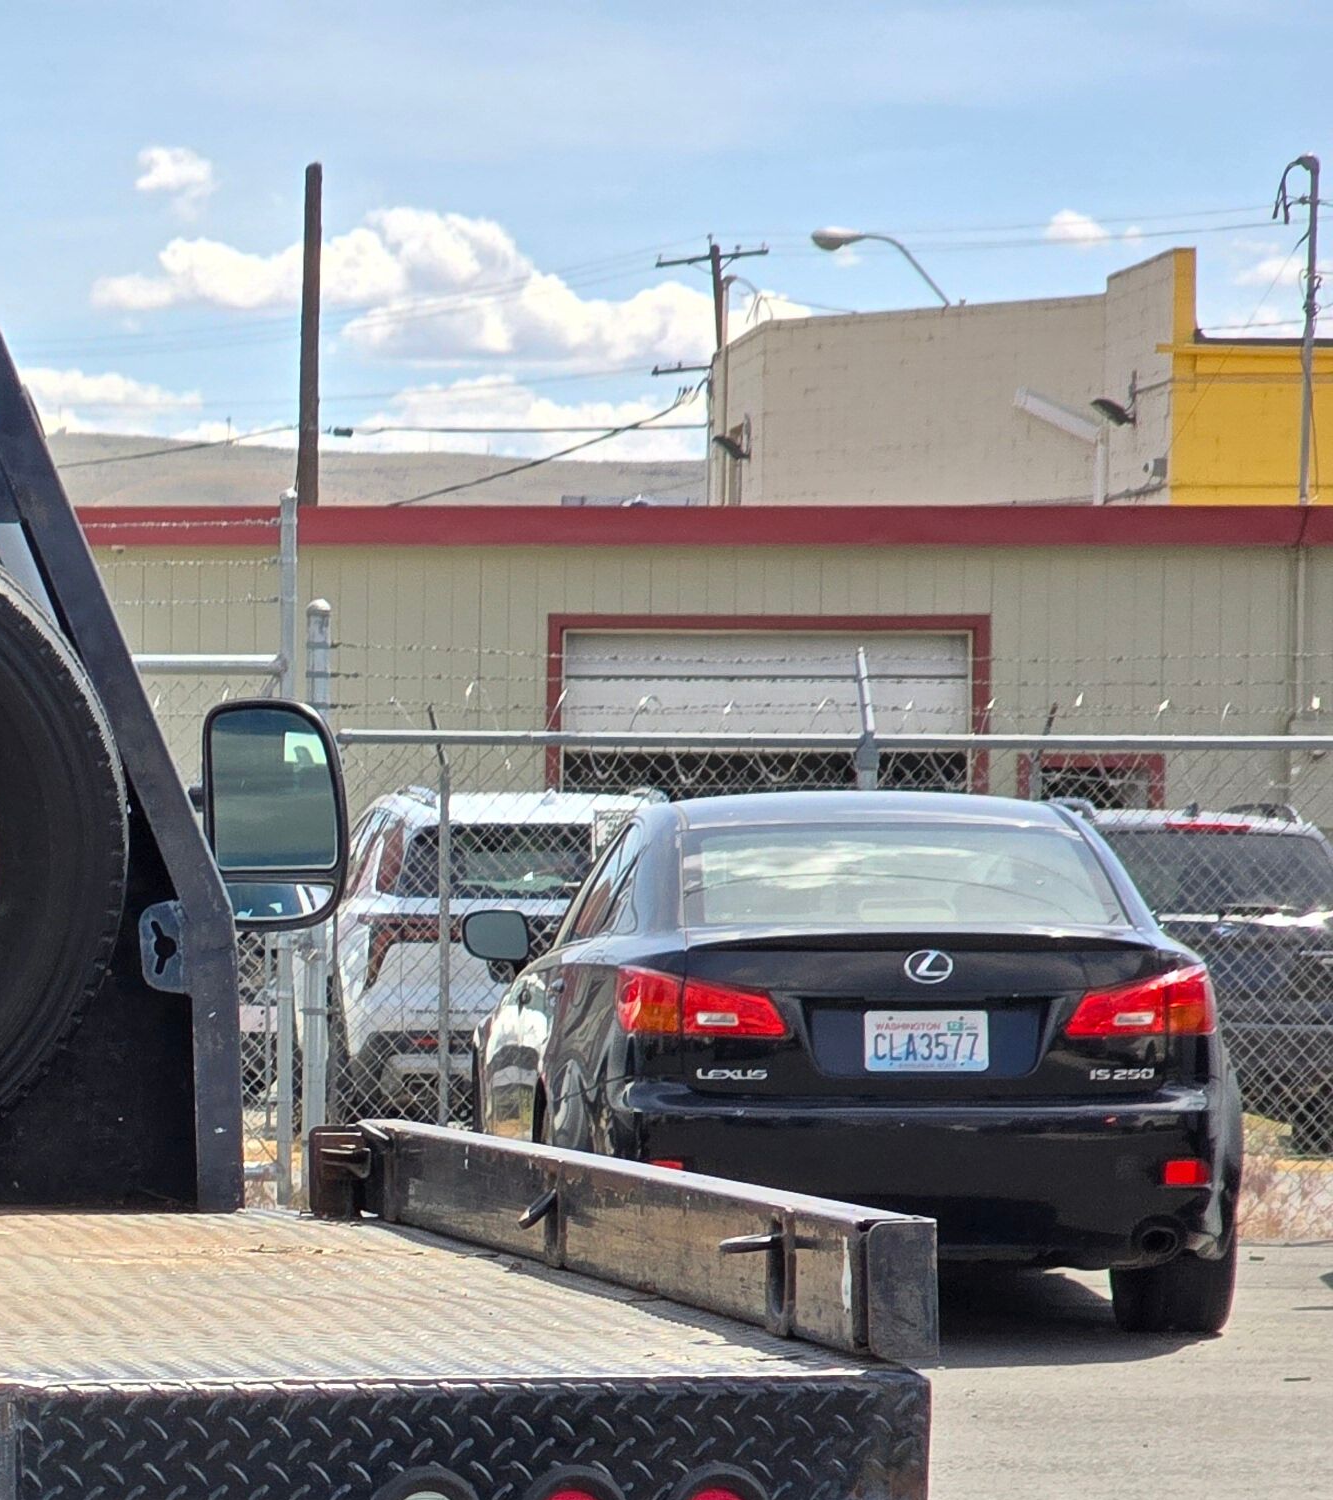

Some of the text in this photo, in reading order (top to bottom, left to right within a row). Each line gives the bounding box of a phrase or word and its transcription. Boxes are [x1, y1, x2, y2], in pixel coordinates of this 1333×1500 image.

[875, 1022, 941, 1031] WASHINGTON
[874, 1032, 979, 1061] CLA3577
[696, 1068, 768, 1080] LEXUS
[1089, 1068, 1155, 1080] IS 250
